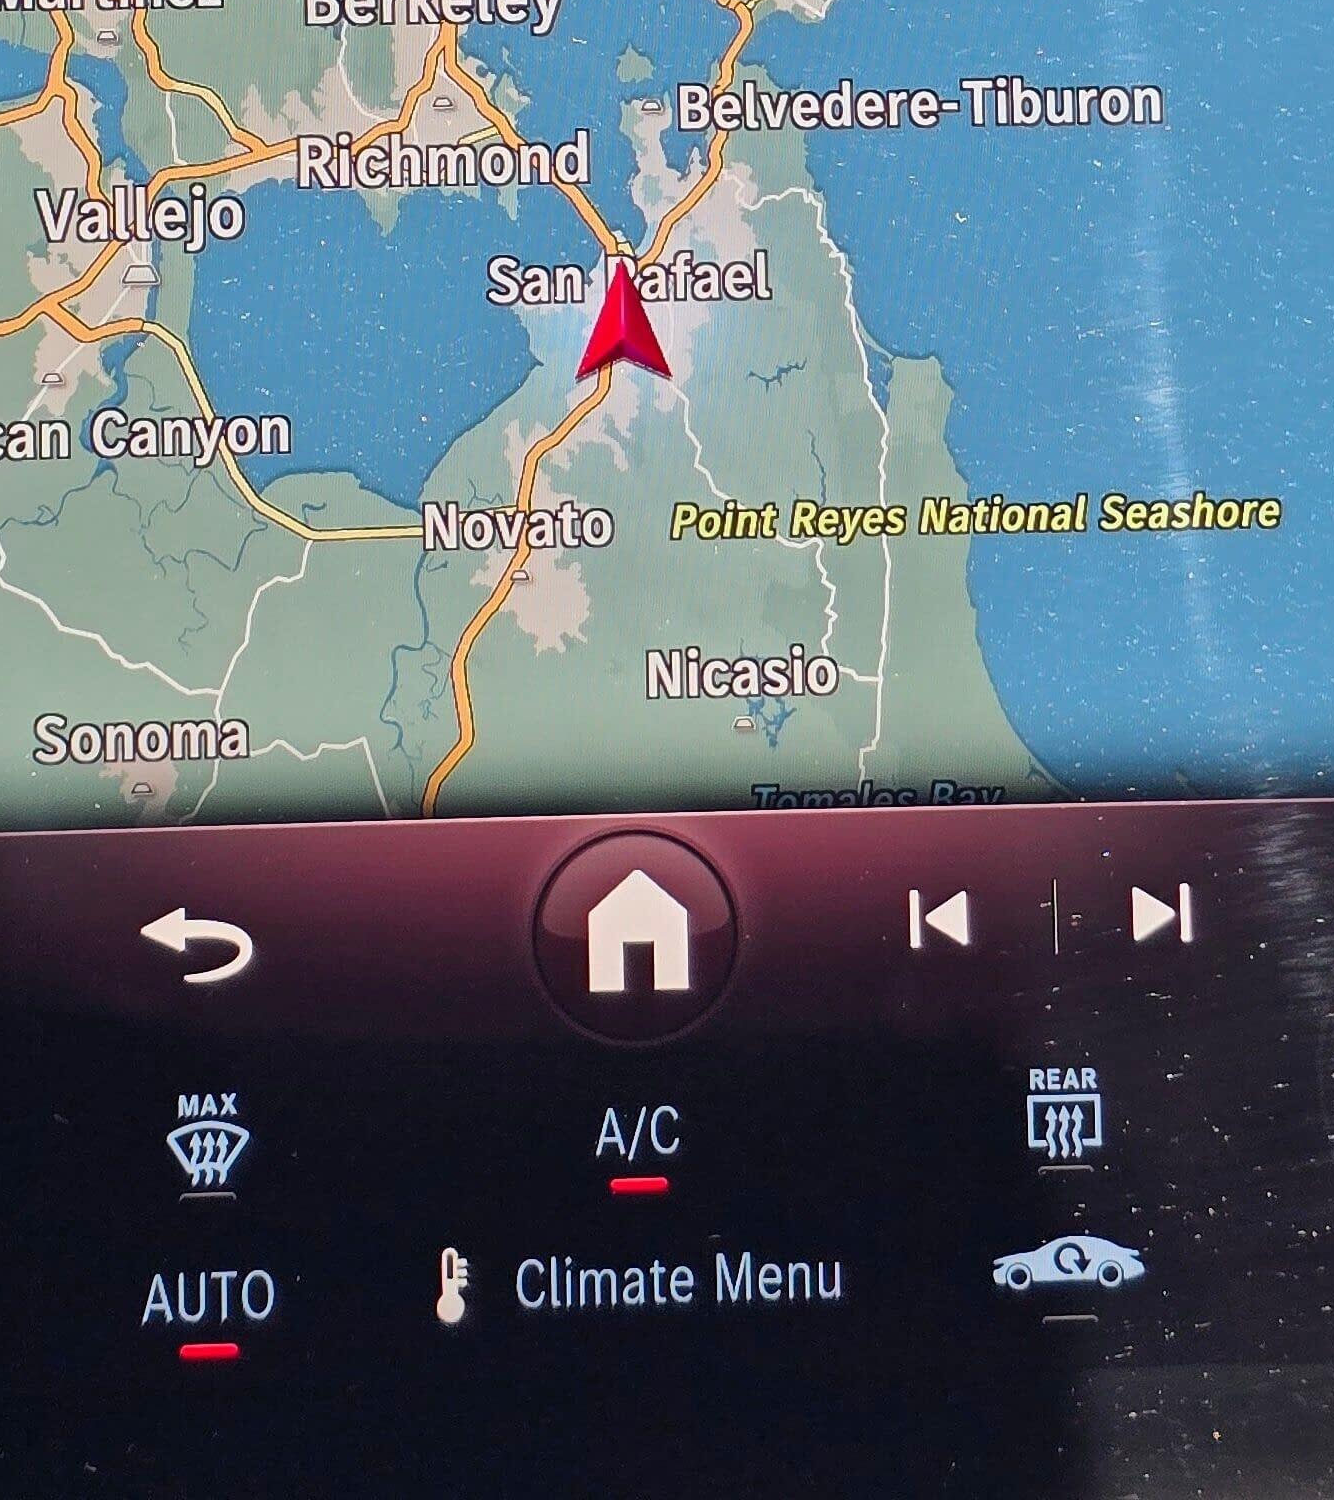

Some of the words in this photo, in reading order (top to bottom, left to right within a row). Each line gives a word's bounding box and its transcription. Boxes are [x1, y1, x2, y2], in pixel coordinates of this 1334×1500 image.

[677, 77, 1164, 131] Belvedere-Tiburon
[297, 130, 591, 190] Richmond
[36, 183, 246, 250] Vallejo
[486, 254, 586, 305] San
[91, 409, 292, 466] Canyon
[421, 502, 615, 552] Novato
[671, 502, 778, 540] Point
[790, 500, 907, 542] Reyes
[919, 495, 1088, 536] National
[1100, 493, 1282, 533] Seashore
[646, 646, 840, 699] Nicasio
[33, 713, 250, 765] Sonoma
[176, 1092, 239, 1119] MAX
[1028, 1067, 1098, 1091] REAR
[594, 1105, 681, 1162] A/C
[141, 1269, 276, 1327] AUTO
[514, 1255, 696, 1309] Climate
[716, 1250, 843, 1301] Menu
